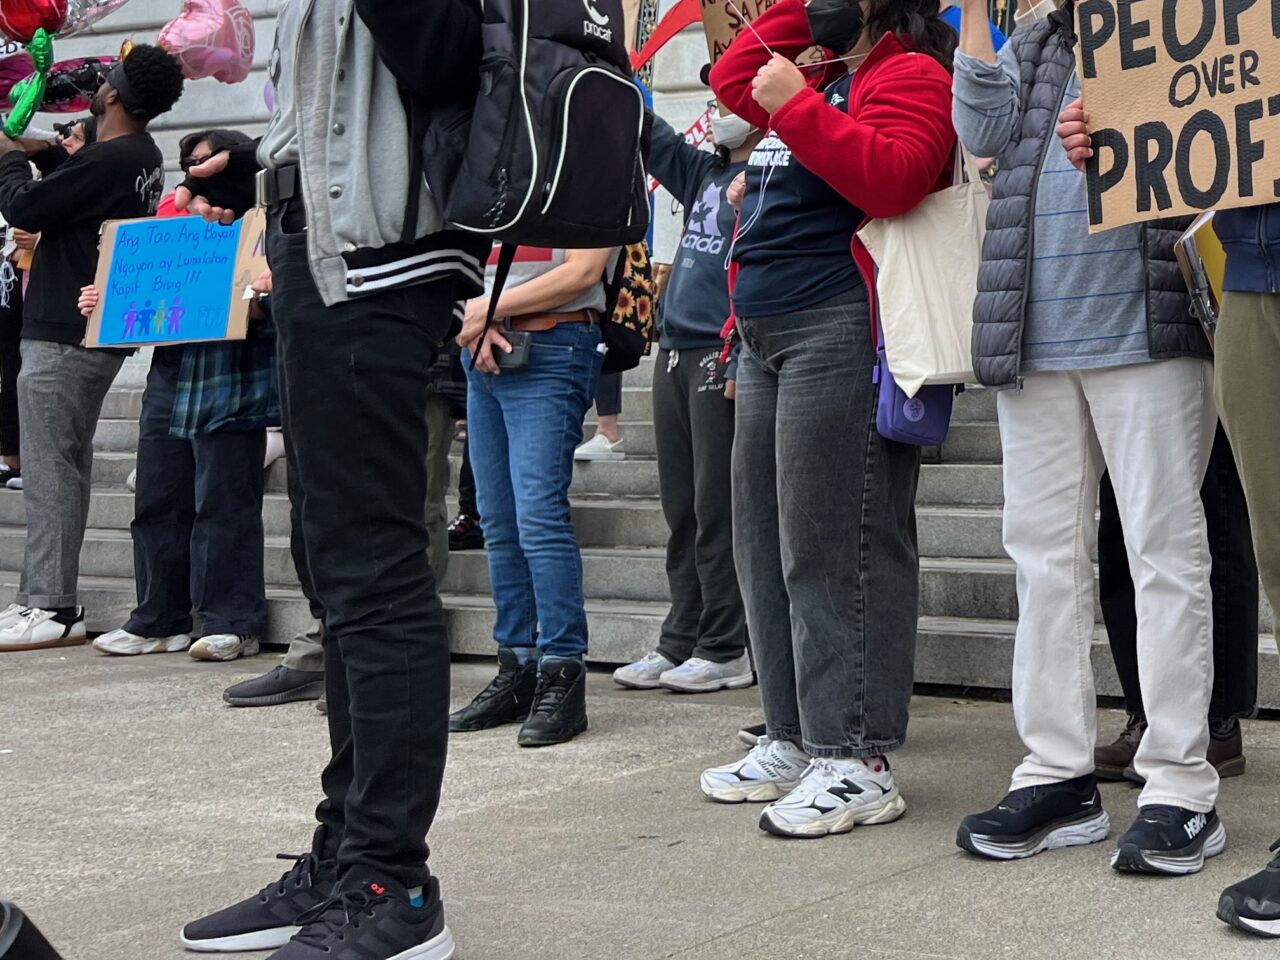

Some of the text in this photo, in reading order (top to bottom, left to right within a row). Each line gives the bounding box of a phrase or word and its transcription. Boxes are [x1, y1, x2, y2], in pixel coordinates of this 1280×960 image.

[725, 1, 753, 29] SA
[583, 20, 612, 43] procat
[1168, 49, 1260, 108] OVER
[117, 231, 140, 254] Ang
[148, 225, 171, 244] Tao
[178, 223, 199, 248] Ang
[159, 259, 173, 271] ay
